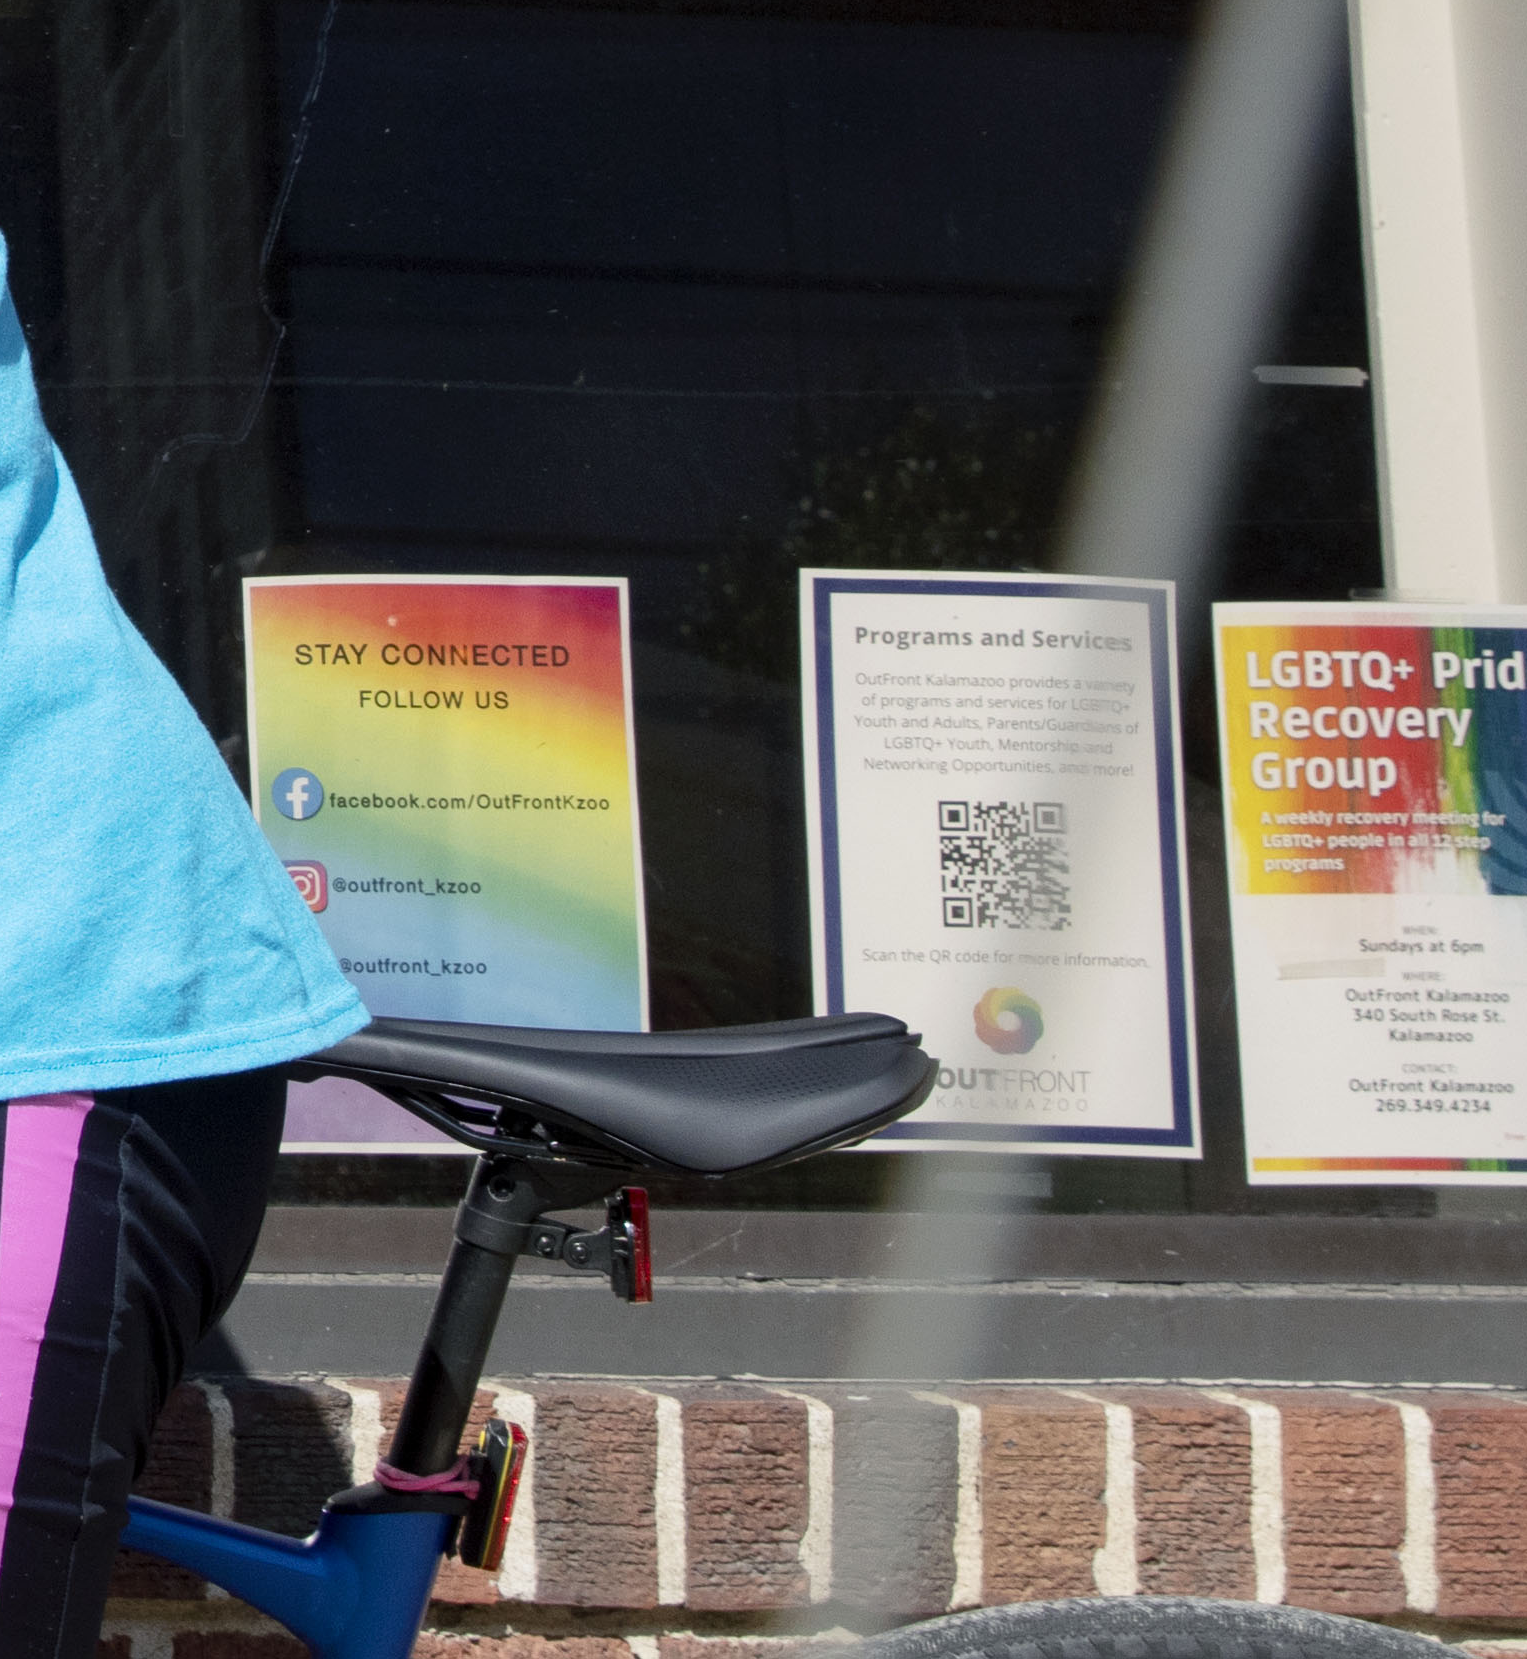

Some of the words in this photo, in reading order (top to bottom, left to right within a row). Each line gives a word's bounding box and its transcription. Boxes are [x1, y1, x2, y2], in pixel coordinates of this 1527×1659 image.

[855, 626, 972, 650] Programs
[981, 628, 1025, 647] and
[1032, 630, 1132, 652] Services
[295, 643, 368, 666] STAY
[381, 644, 570, 667] CONNECTED
[1246, 650, 1415, 692] LGBTQ+
[855, 672, 922, 687] OutFront
[925, 674, 1005, 688] Kalamazoo
[1009, 675, 1069, 693] provides
[1073, 679, 1082, 690] a
[359, 690, 464, 709] FOLLOW
[475, 691, 509, 709] US
[861, 693, 877, 708] of
[880, 696, 951, 713] programs
[955, 694, 983, 709] and
[987, 696, 1043, 710] services
[1047, 696, 1068, 711] for
[854, 714, 897, 729] Youth
[900, 715, 929, 729] and
[932, 716, 983, 732] Adults,
[1125, 719, 1139, 734] of
[1249, 701, 1472, 747] Recovery
[884, 736, 943, 752] LGBTQ+
[947, 737, 994, 752] Youth,
[863, 757, 948, 775] Networking
[1251, 751, 1398, 797] Group
[329, 792, 610, 811] facebook.com/OutFrontKzoo
[1260, 812, 1272, 825] A
[1274, 811, 1332, 827] weekly
[1336, 812, 1408, 827] recovery
[1412, 812, 1479, 828] meeting
[1482, 812, 1506, 826] for
[1263, 833, 1324, 848] LGBTQ+
[1328, 833, 1384, 850] people
[1388, 833, 1404, 847] in
[1408, 833, 1429, 847] all
[1264, 857, 1345, 873] programs
[332, 877, 482, 896] @outfront_kzoo
[1359, 939, 1423, 955] Sundays
[1429, 941, 1445, 952] at
[862, 948, 896, 963] Scan
[901, 949, 925, 963] the
[929, 949, 951, 965] QR
[955, 950, 989, 964] code
[993, 950, 1012, 964] for
[339, 958, 488, 977] @outfront_kzoo
[1345, 988, 1420, 1002] OutFront
[1426, 989, 1510, 1003] Kalamazoo
[1353, 1008, 1385, 1022] 340
[1389, 1008, 1436, 1022] South
[1442, 1009, 1478, 1022] Rose
[1483, 1009, 1506, 1023] St.
[1389, 1029, 1474, 1042] Kalamazoo
[1349, 1078, 1424, 1092] OutFront
[1430, 1079, 1515, 1093] Kalamazoo
[1375, 1098, 1492, 1113] 269.349.4234
